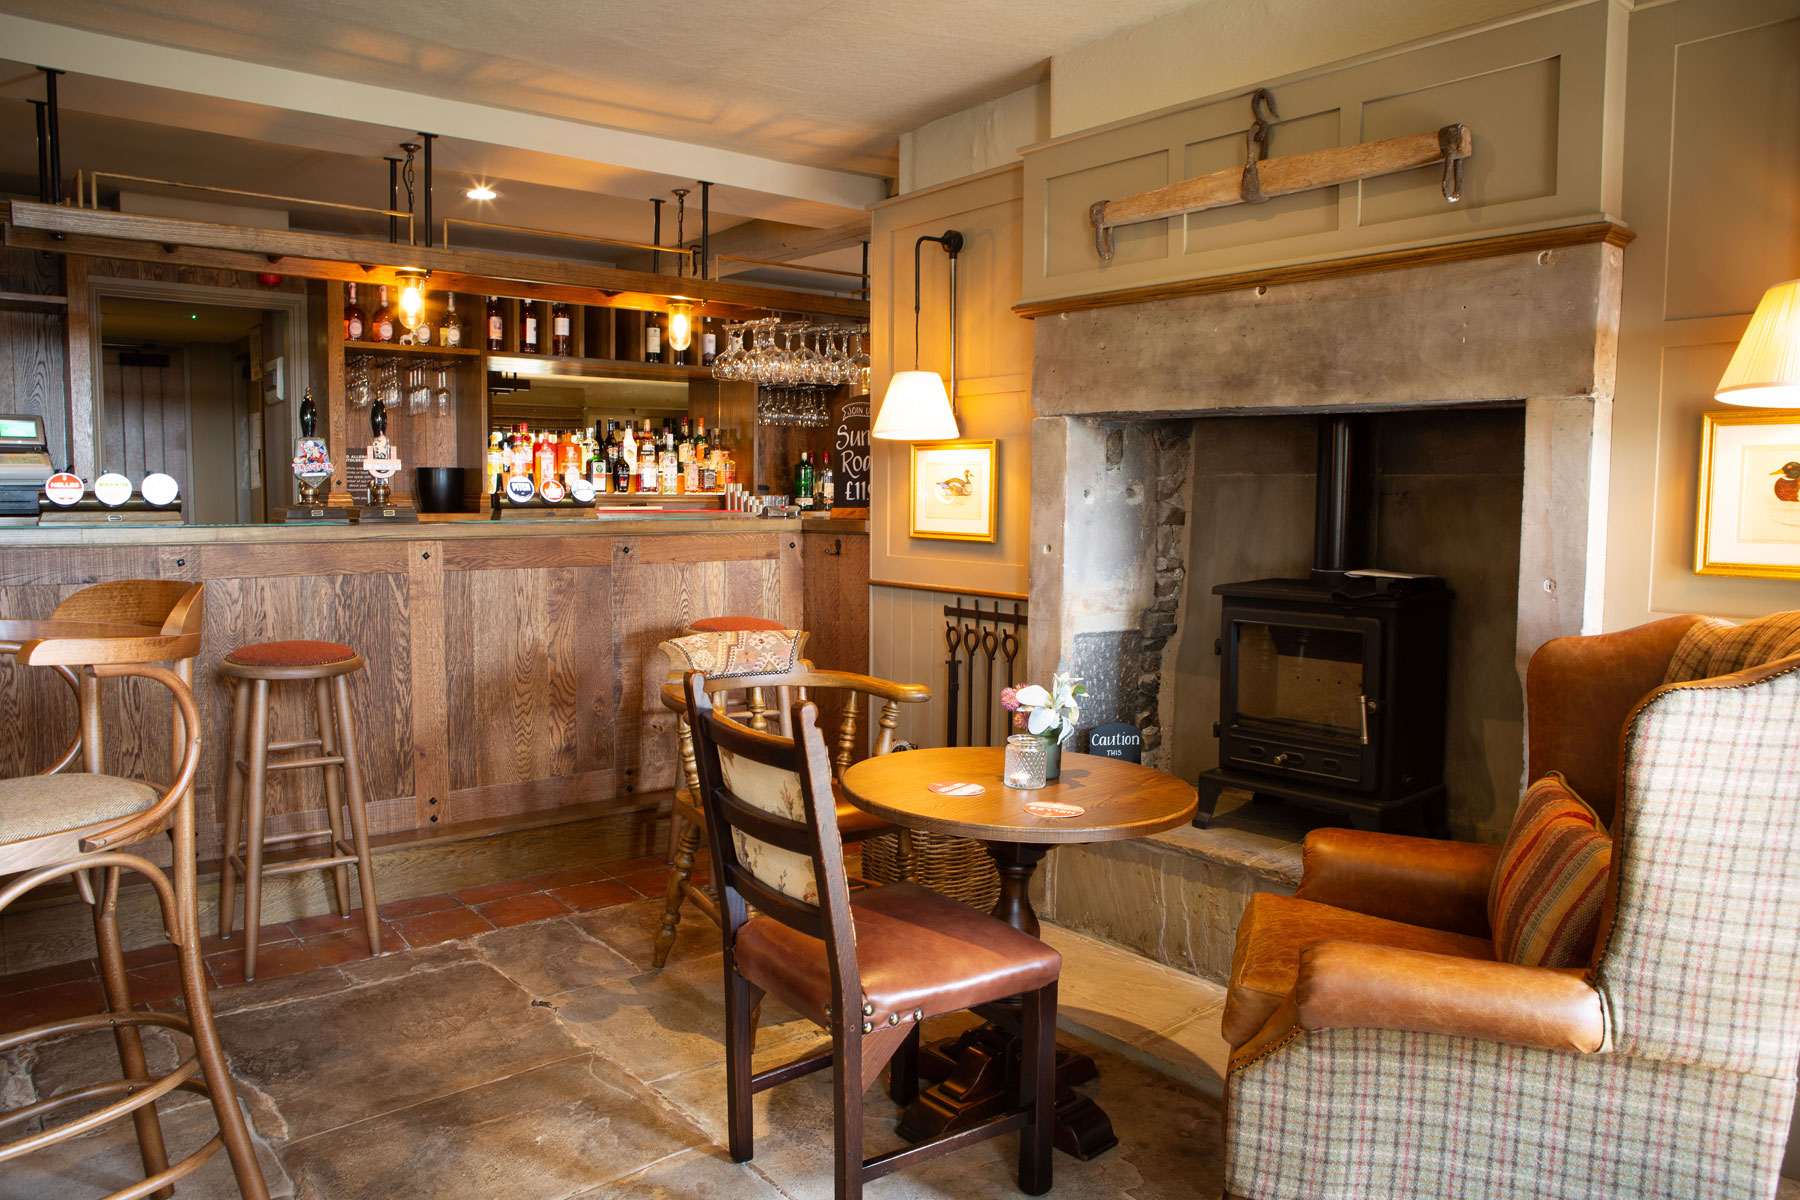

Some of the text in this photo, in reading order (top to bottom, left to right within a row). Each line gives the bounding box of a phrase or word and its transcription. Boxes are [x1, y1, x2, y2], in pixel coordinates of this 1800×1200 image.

[847, 406, 863, 416] JOIN
[1091, 731, 1140, 746] Caution
[1106, 749, 1122, 757] THIS
